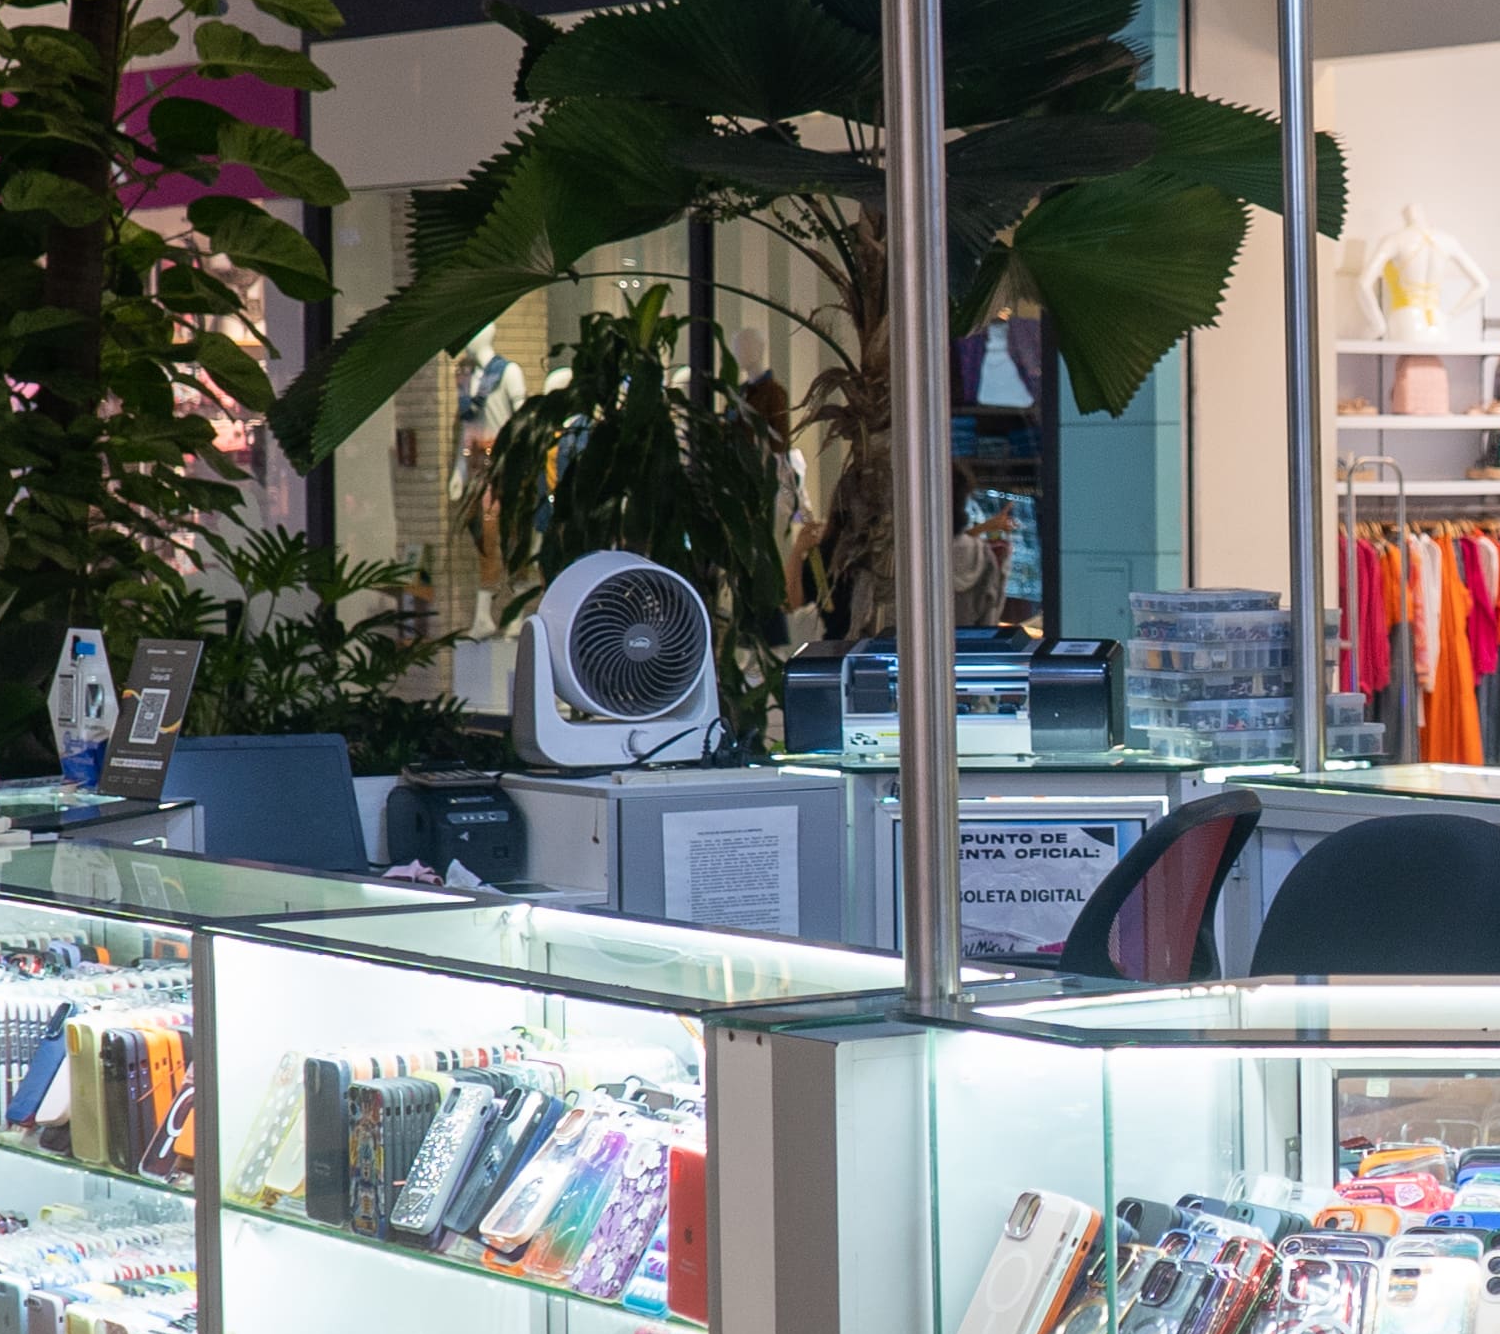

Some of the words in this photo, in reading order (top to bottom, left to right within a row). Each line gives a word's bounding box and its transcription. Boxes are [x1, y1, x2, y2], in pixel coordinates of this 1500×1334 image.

[961, 833, 1032, 845] PUNTO
[1041, 833, 1068, 844] DE
[958, 849, 1006, 860] ENTA
[1015, 848, 1100, 859] OFICIAL:
[1021, 889, 1086, 902] DIGITAL
